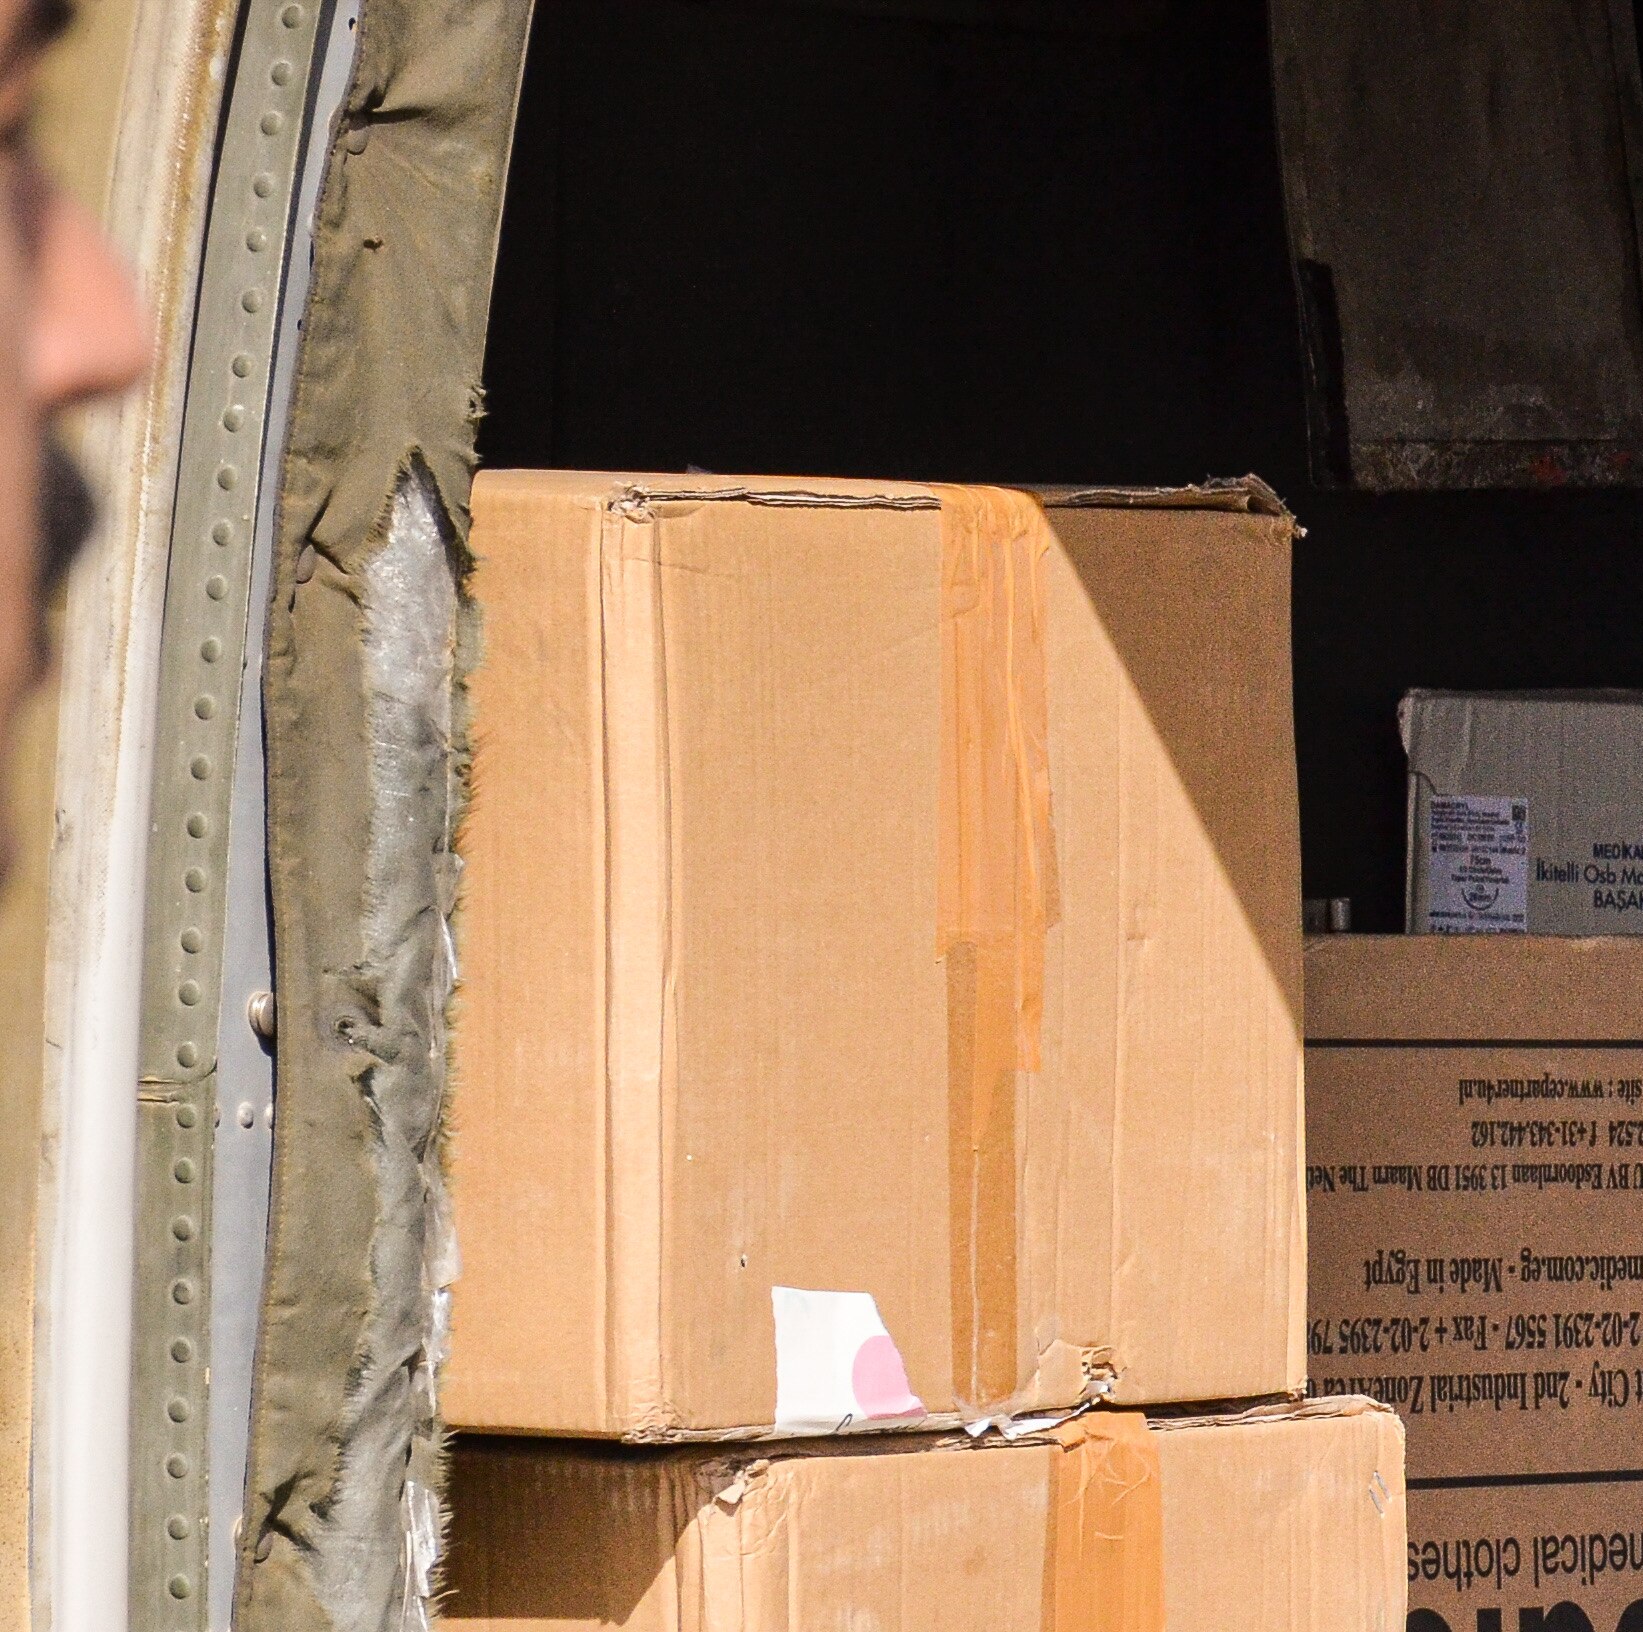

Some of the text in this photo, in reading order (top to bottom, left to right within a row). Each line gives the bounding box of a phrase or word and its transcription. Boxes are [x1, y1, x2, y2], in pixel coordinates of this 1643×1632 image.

[1583, 860, 1617, 885] Osb
[1458, 1072, 1605, 1106] www.cepartner4u.nl
[1616, 1078, 1643, 1105] site
[1338, 1164, 1370, 1193] The
[1372, 1163, 1424, 1192] Maarn
[1425, 1163, 1451, 1192] DB
[1453, 1163, 1489, 1192] 3951
[1490, 1163, 1508, 1191] 13
[1511, 1161, 1604, 1190] Esdoornlaan
[1606, 1161, 1630, 1190] BV
[1363, 1248, 1422, 1295] Egypt
[1426, 1258, 1446, 1294] in
[1449, 1257, 1503, 1294] Made
[1338, 1315, 1431, 1355] 2-02-2395
[1452, 1315, 1488, 1351] Fax
[1504, 1313, 1548, 1351] 5567
[1552, 1311, 1641, 1350] 2-02-2391
[1429, 1371, 1528, 1414] Industrial
[1533, 1369, 1572, 1410] 2nd
[1587, 1359, 1631, 1409] City
[1406, 1537, 1521, 1593] clothes
